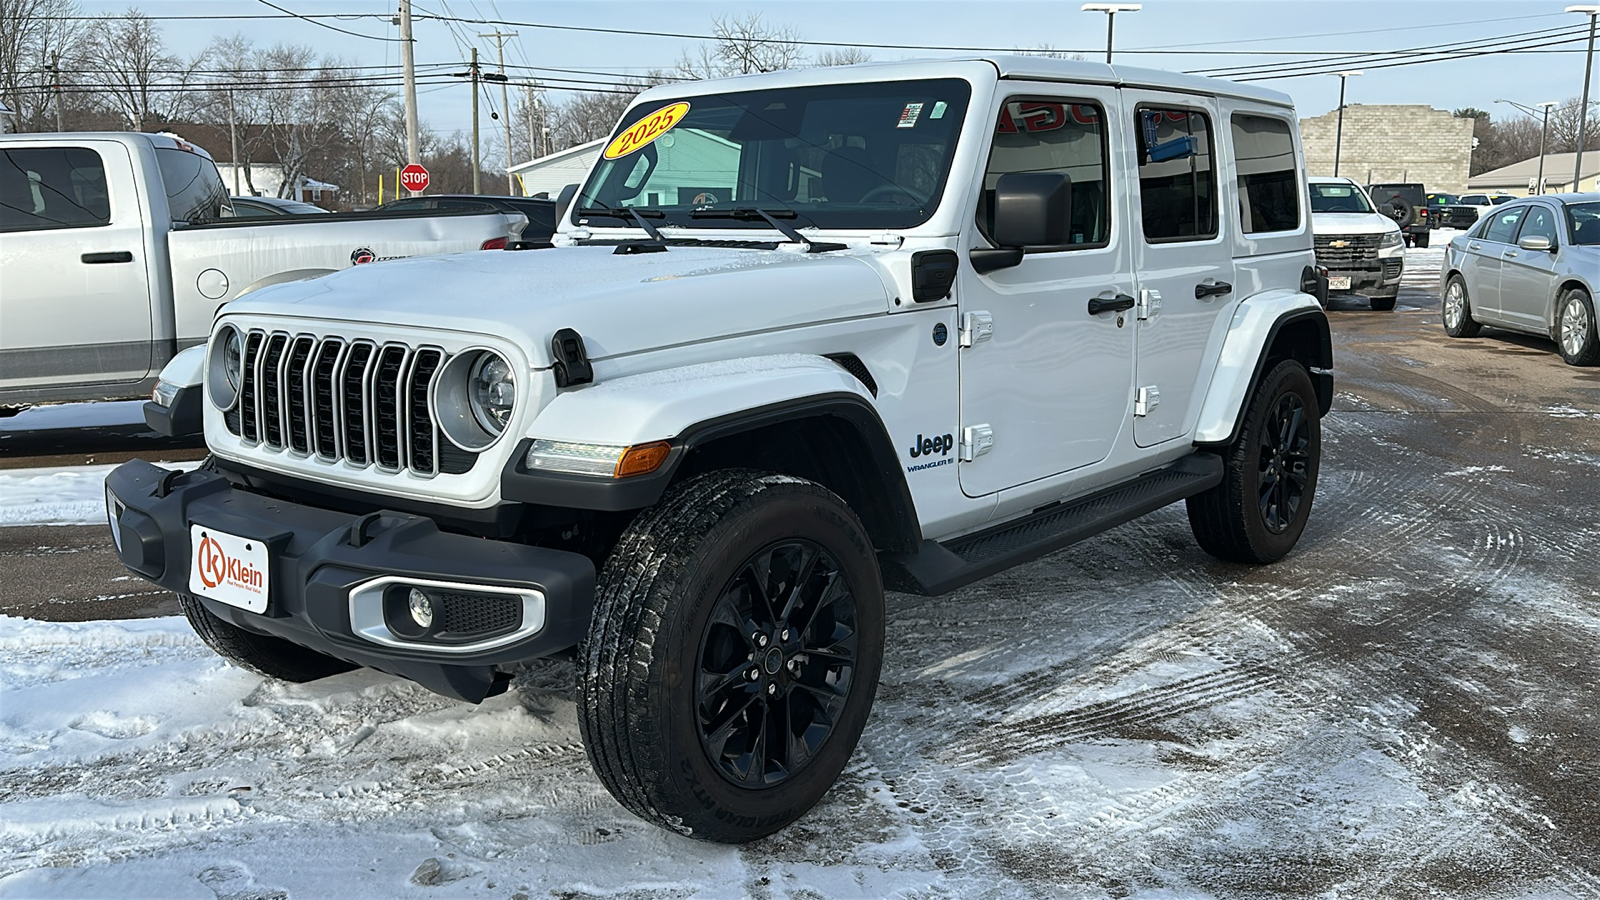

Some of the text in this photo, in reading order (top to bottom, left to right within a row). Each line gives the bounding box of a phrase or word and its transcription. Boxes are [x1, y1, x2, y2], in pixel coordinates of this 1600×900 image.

[618, 107, 677, 155] 2025
[403, 172, 427, 184] STOP
[909, 433, 953, 458] Jeep
[907, 460, 947, 473] WRANGLER
[227, 556, 262, 588] Klein
